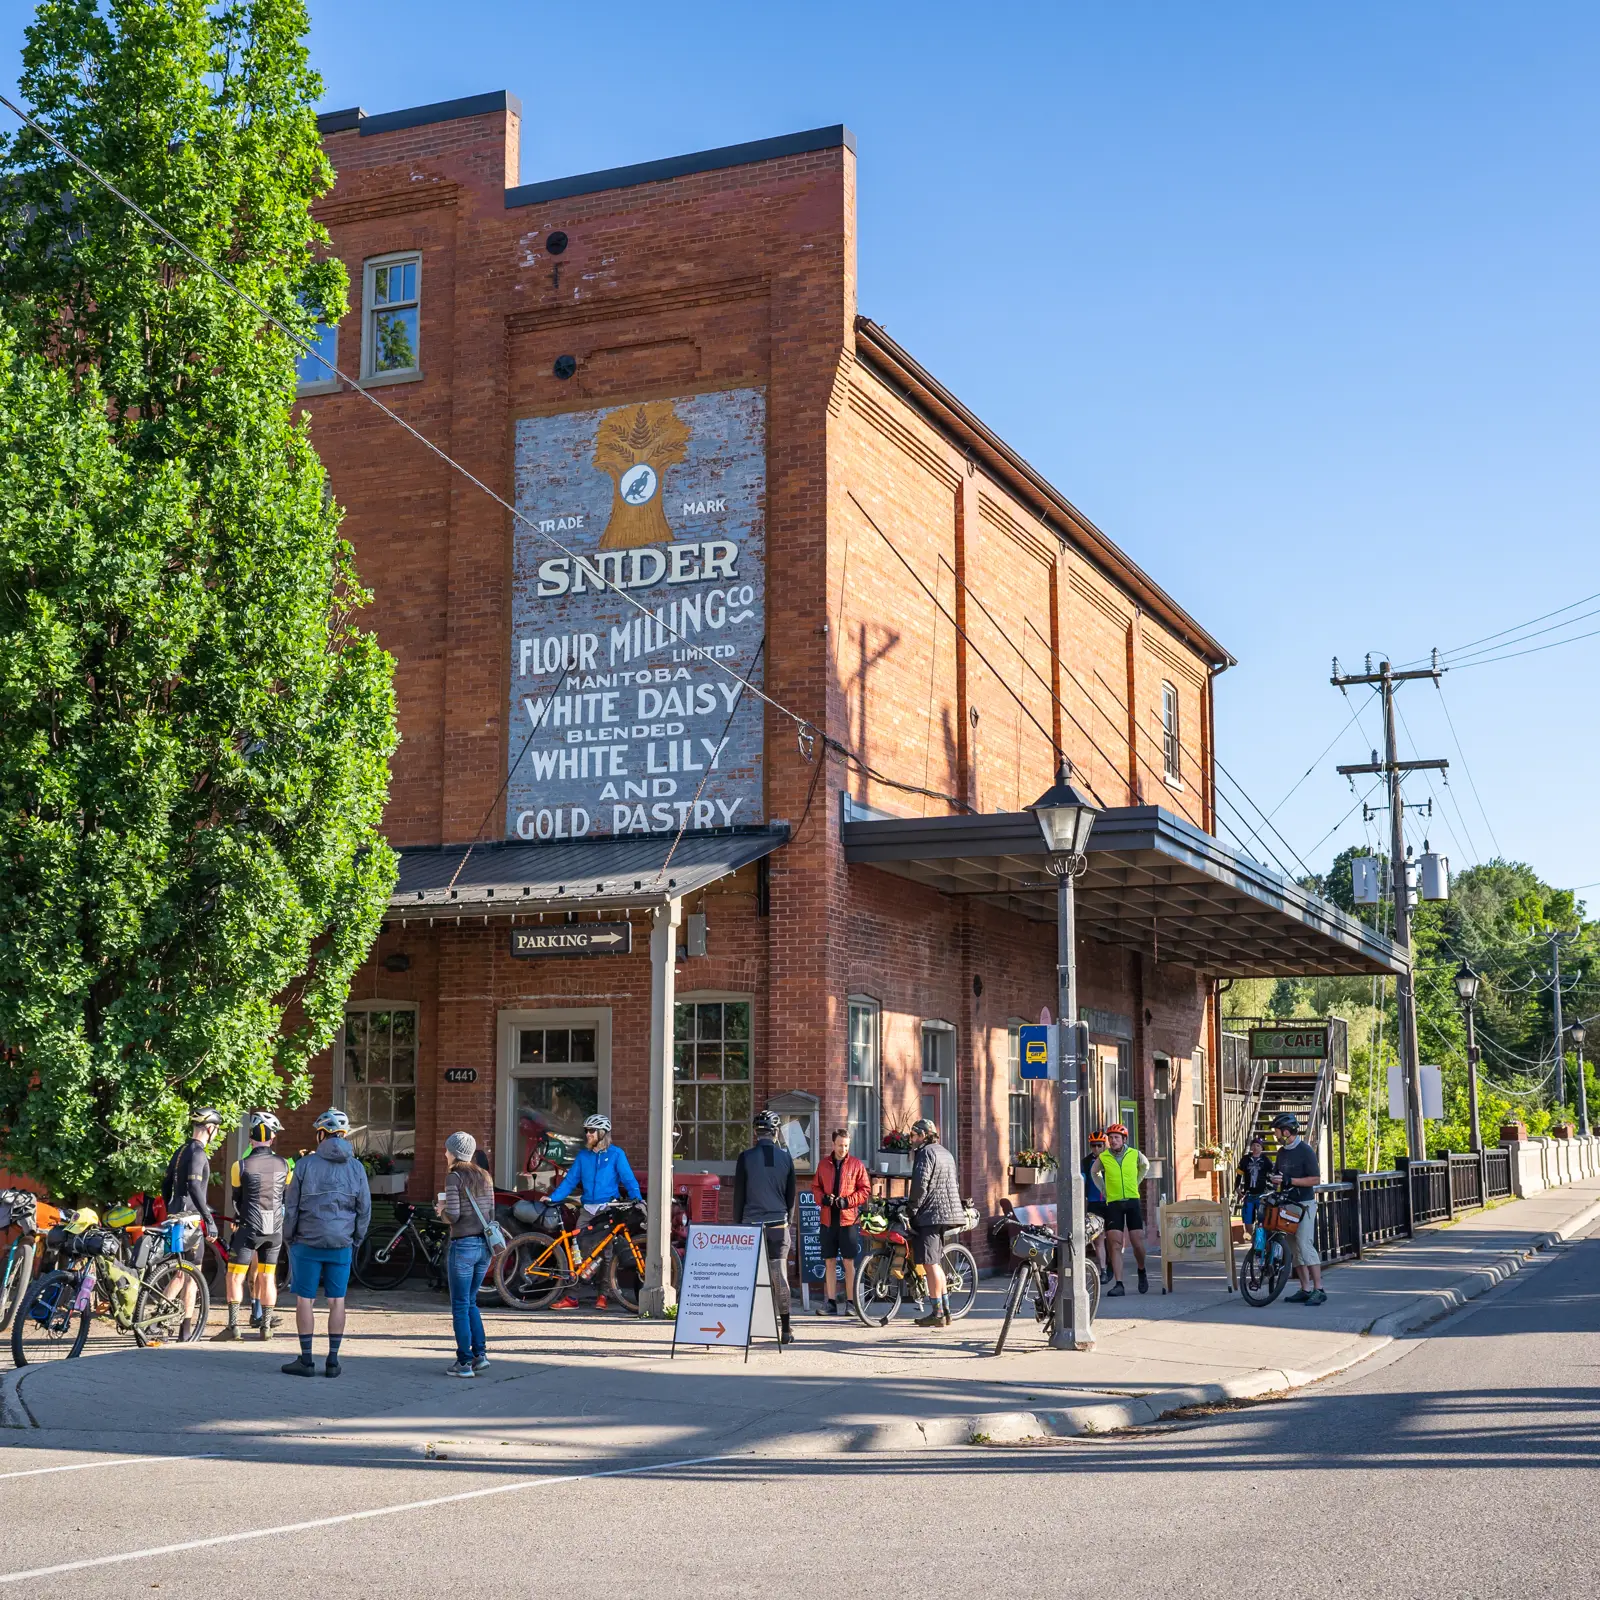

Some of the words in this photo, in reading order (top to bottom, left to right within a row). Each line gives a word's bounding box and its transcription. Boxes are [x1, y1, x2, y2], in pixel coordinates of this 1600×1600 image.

[683, 499, 726, 516] MARK
[539, 515, 584, 533] TRADE
[537, 540, 740, 598] SNIDER
[519, 633, 599, 676] FLOUR
[610, 589, 726, 667] MILLING
[726, 585, 754, 607] CO
[673, 644, 736, 663] LIMITED
[566, 667, 692, 690] MANITOBA
[524, 691, 620, 728] WHITE
[637, 681, 744, 719] DAISY
[567, 722, 685, 743] BLENDED
[531, 744, 629, 781] WHITE
[647, 737, 730, 774] LILY
[599, 778, 677, 800] AND
[516, 808, 590, 840] GOLD
[613, 797, 743, 835] PASTRY
[517, 933, 588, 949] PARKING
[449, 1070, 474, 1081] 1441
[800, 1192, 816, 1204] CYCL
[710, 1234, 755, 1245] CHANGE
[1174, 1232, 1217, 1248] OPEN
